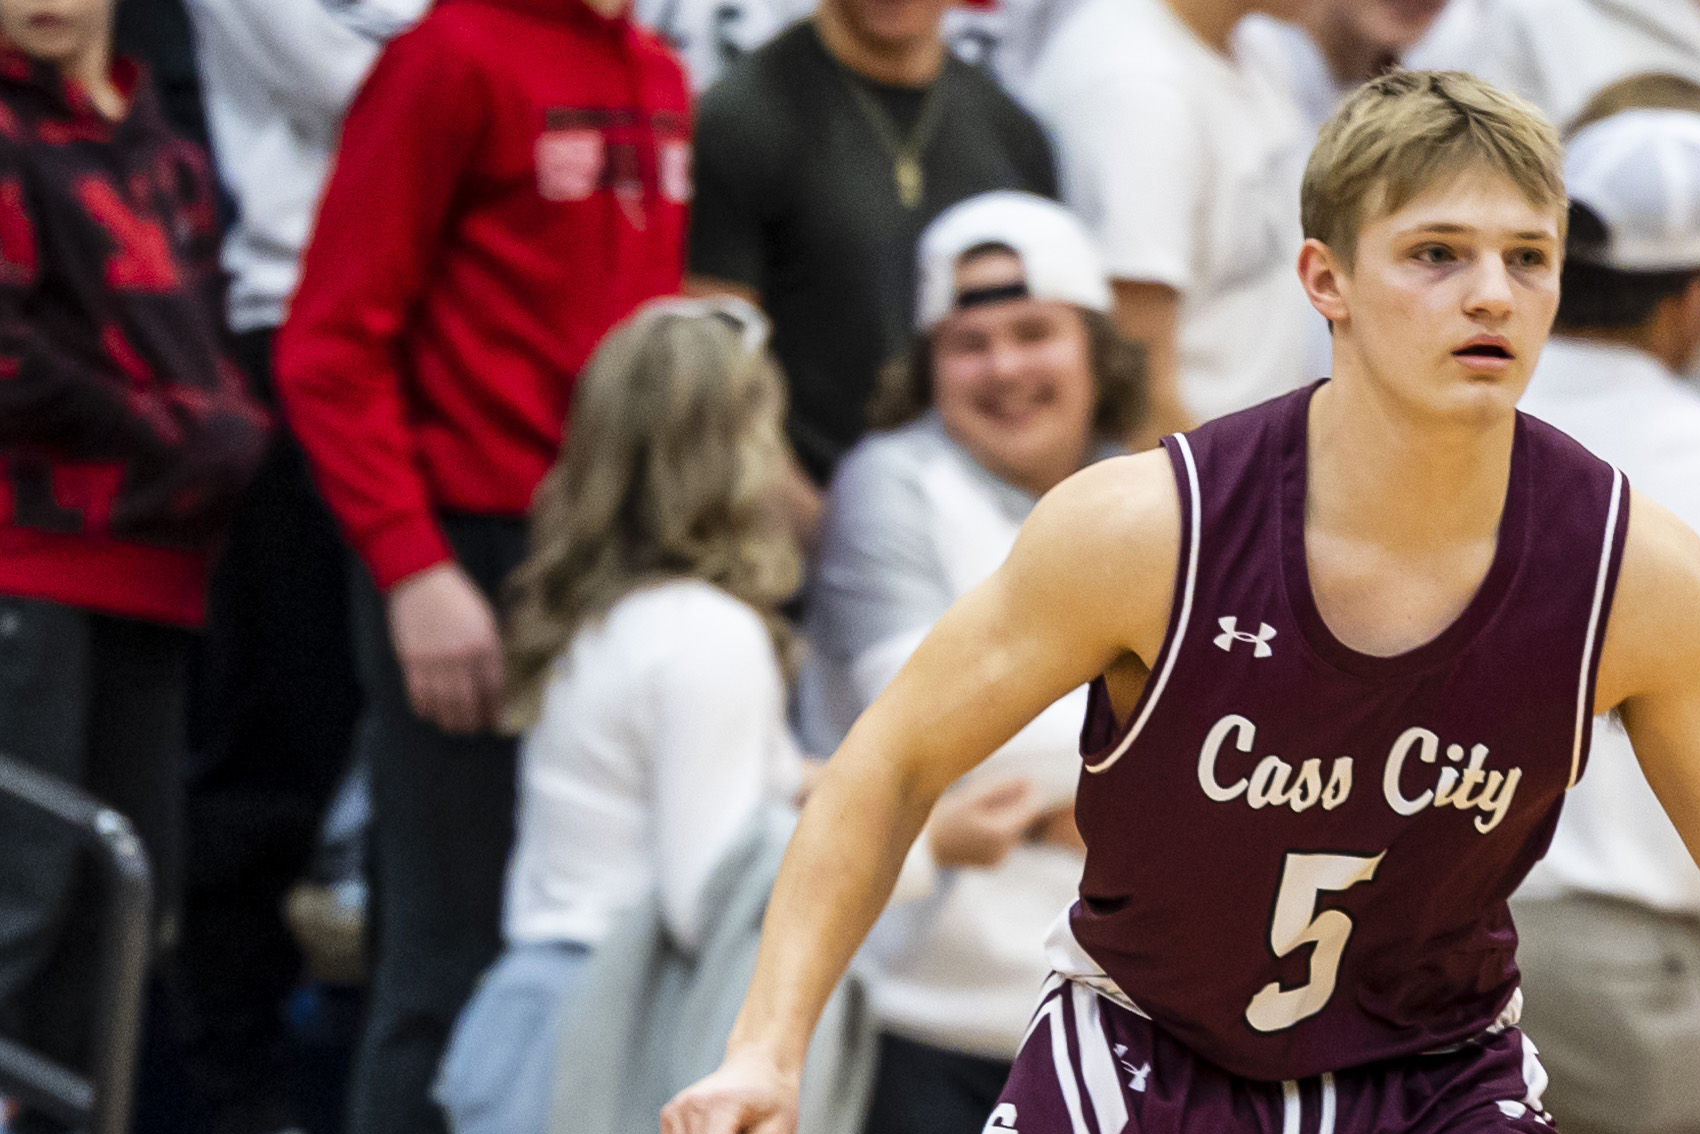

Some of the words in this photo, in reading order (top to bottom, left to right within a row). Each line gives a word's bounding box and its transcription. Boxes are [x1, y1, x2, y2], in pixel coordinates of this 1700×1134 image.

[1197, 713, 1354, 813] Cass
[1382, 726, 1522, 834] City
[1245, 849, 1388, 1033] 5
